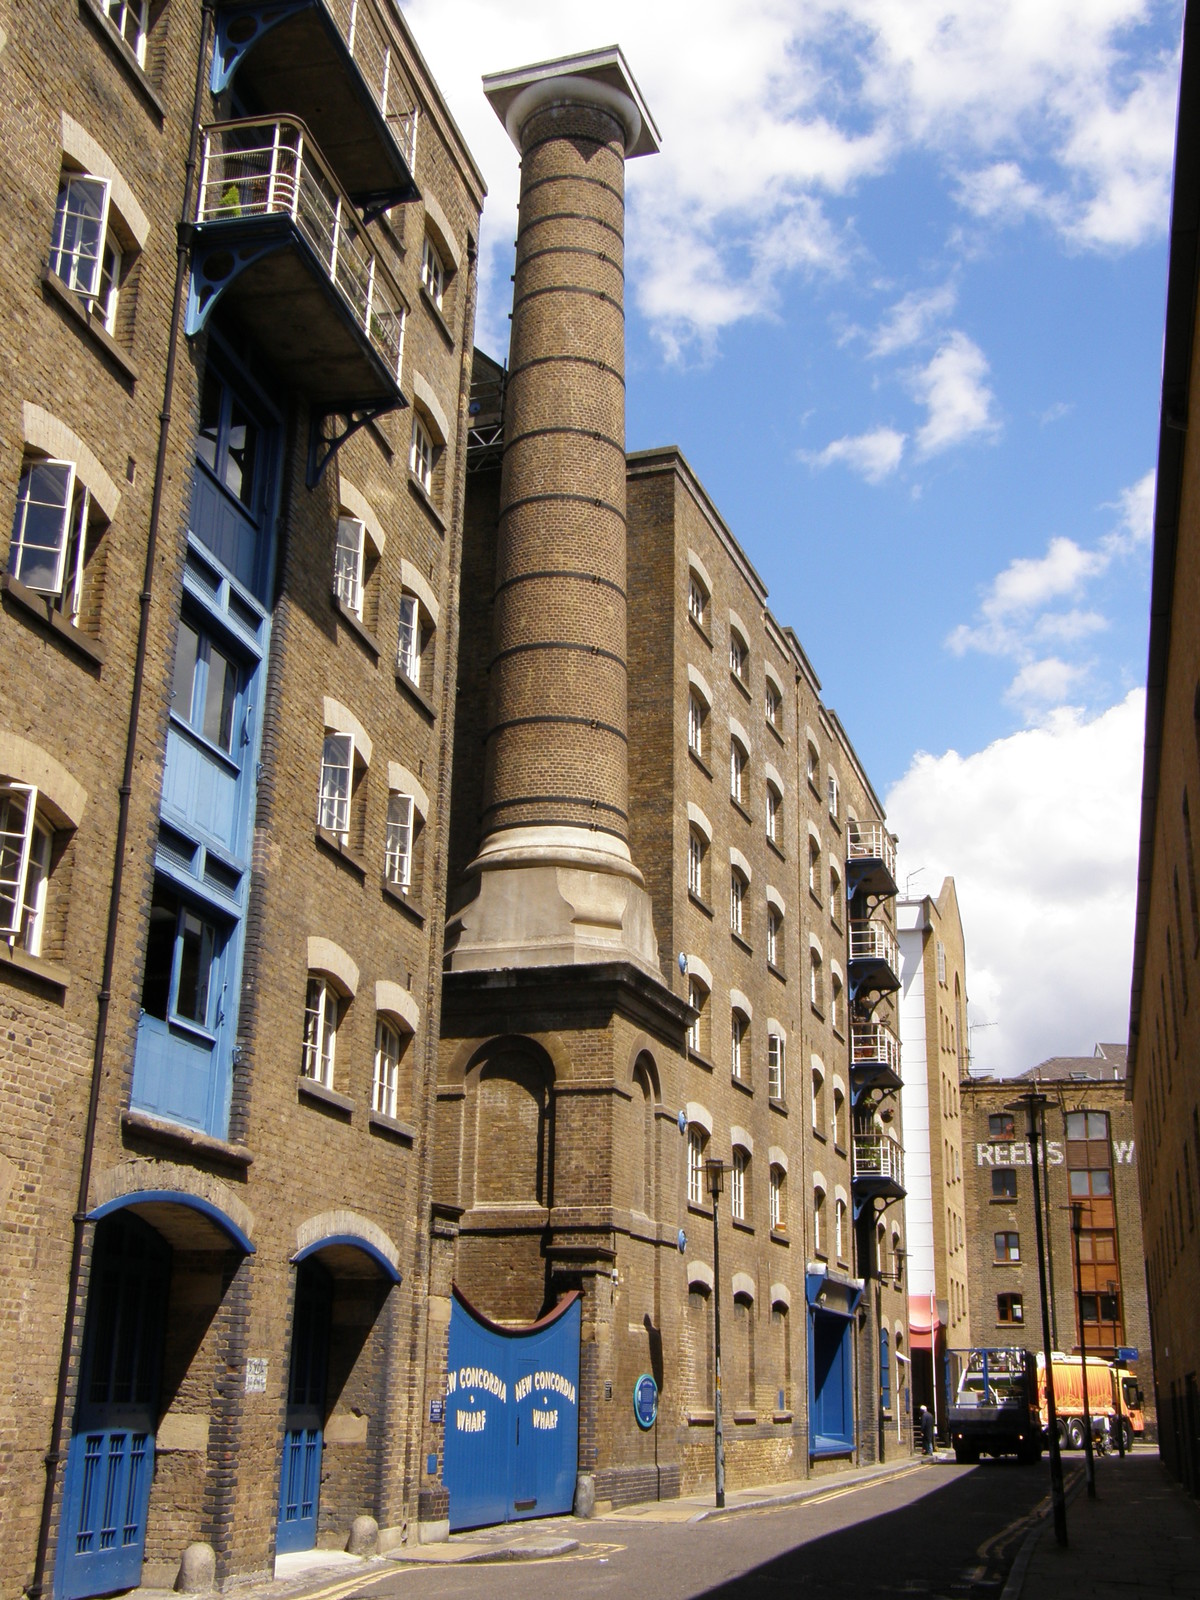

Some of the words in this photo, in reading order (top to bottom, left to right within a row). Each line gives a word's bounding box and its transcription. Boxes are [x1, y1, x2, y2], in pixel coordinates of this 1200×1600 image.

[459, 1367, 507, 1404] CONCORDIA
[514, 1374, 532, 1403] NEW
[534, 1371, 576, 1405] CONCORDIA
[456, 1409, 486, 1433] WHARF
[532, 1408, 559, 1430] WHARF
